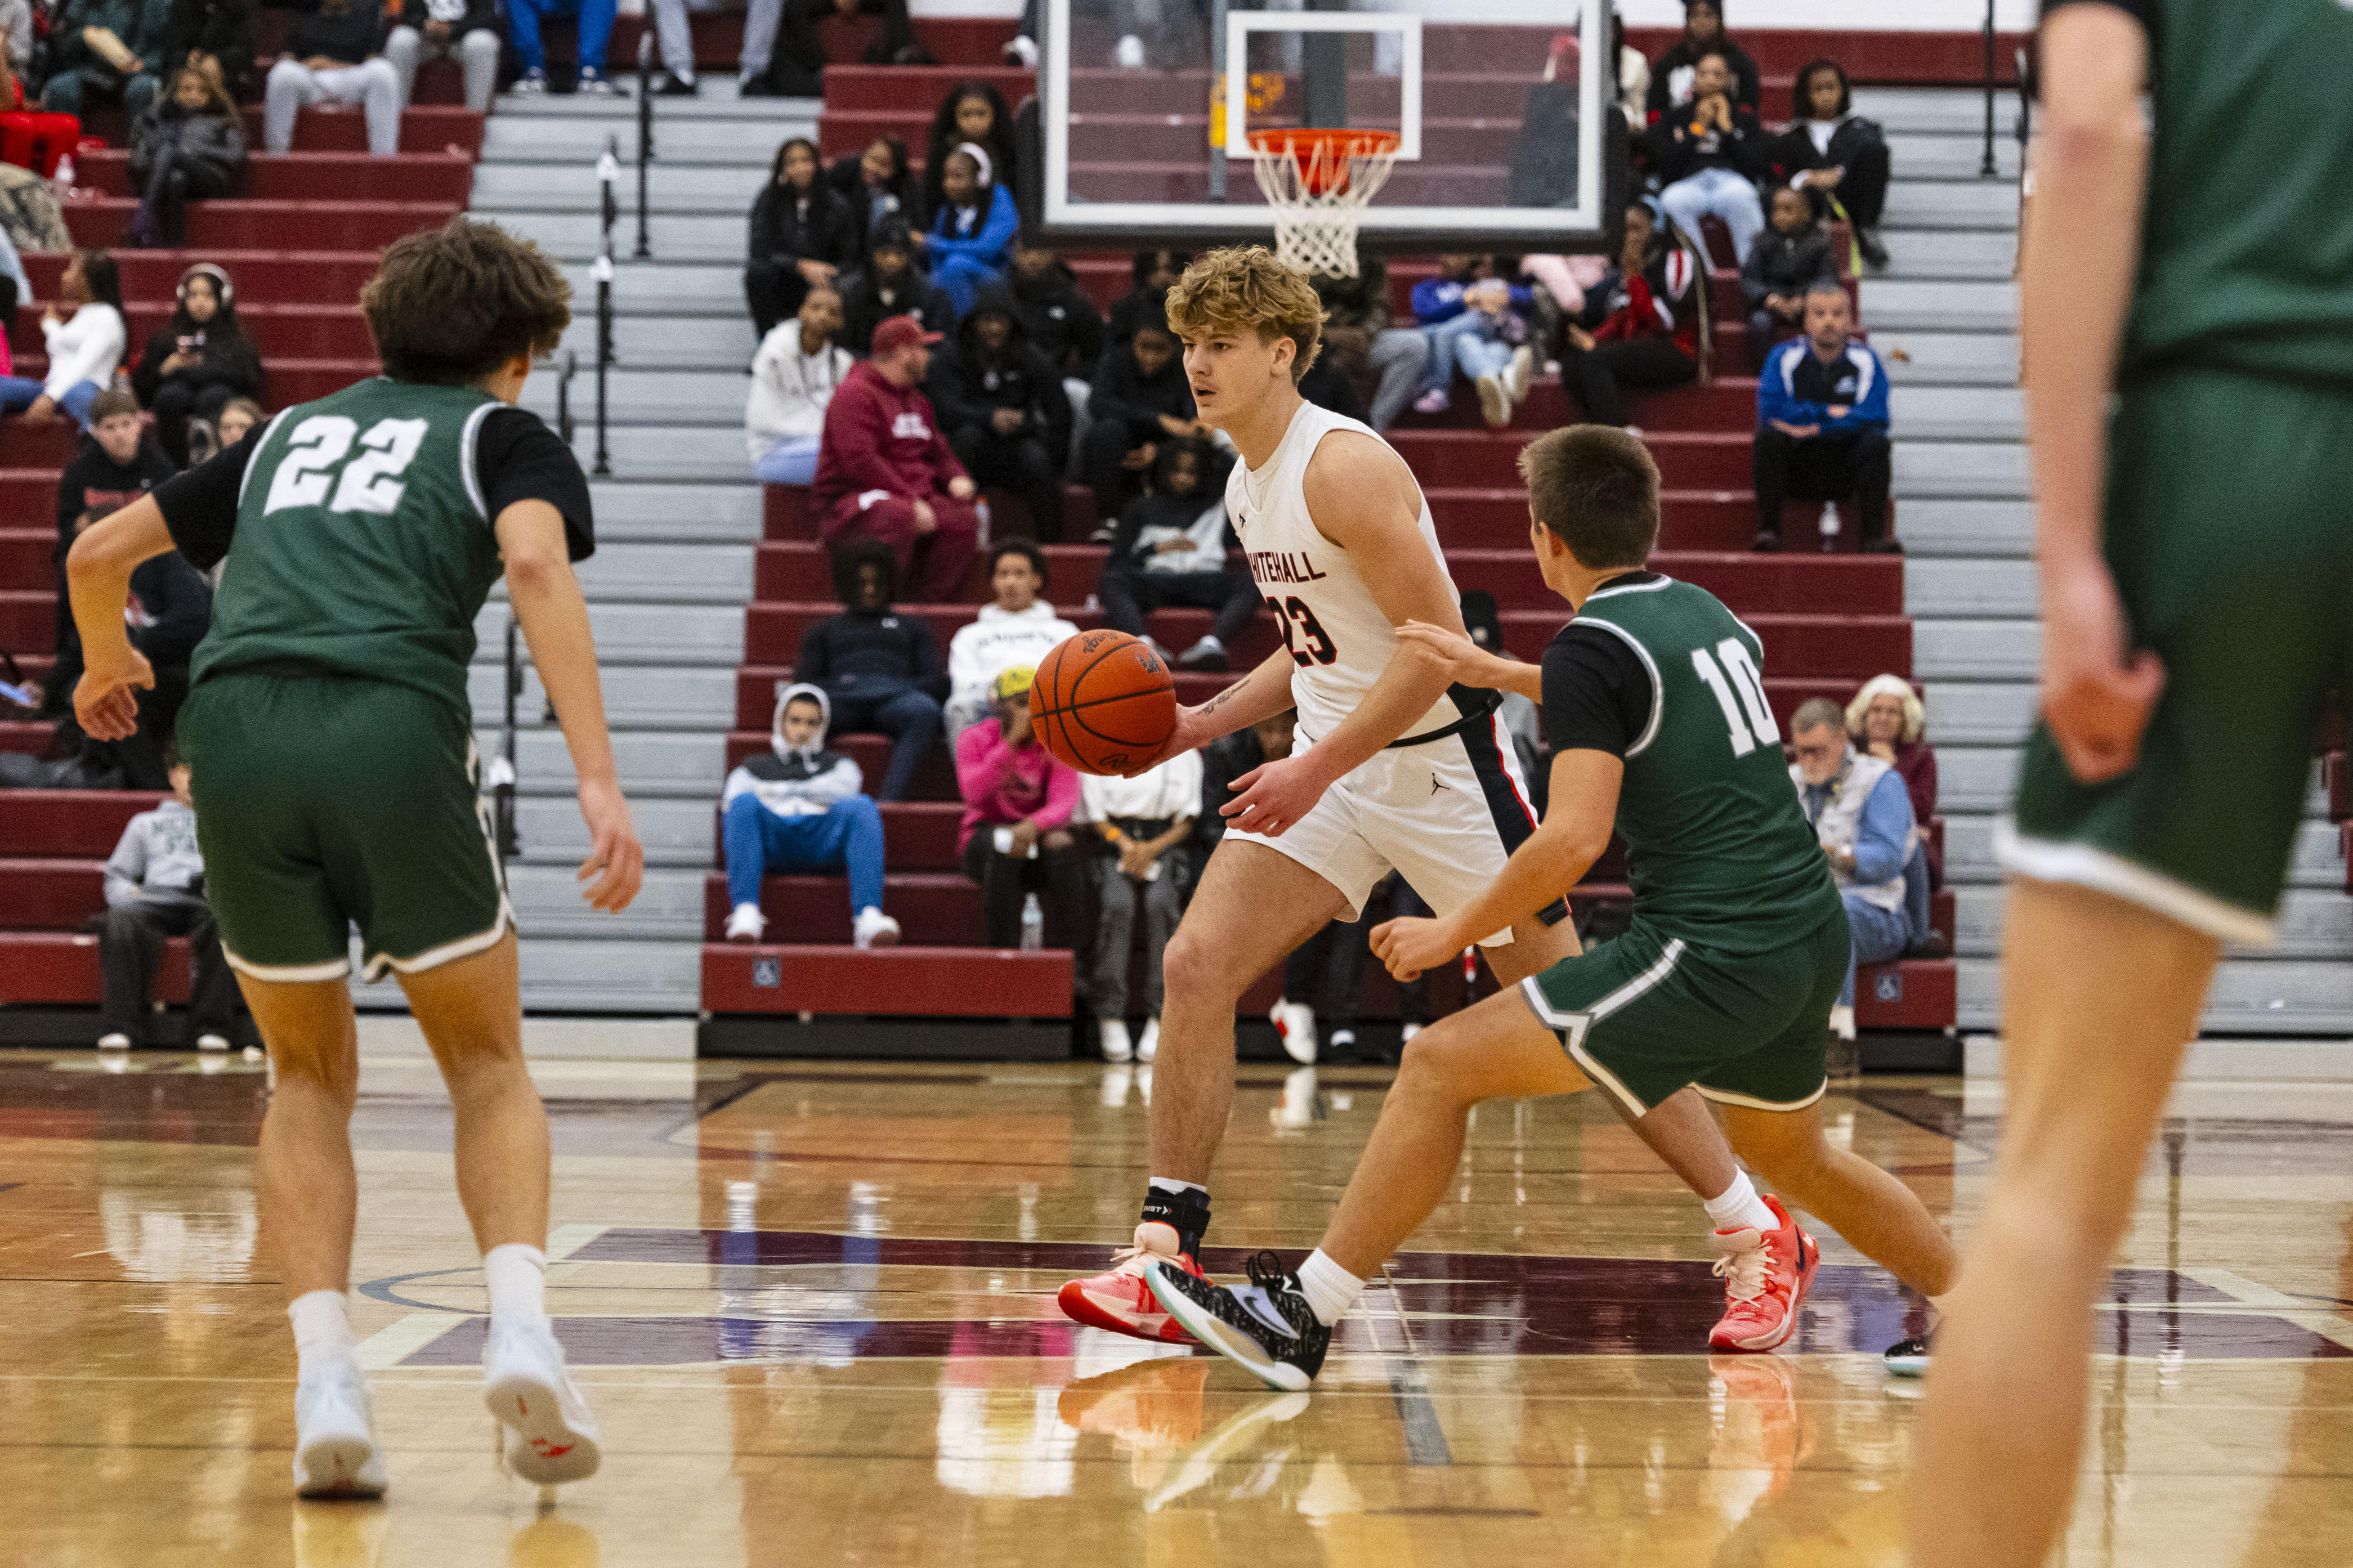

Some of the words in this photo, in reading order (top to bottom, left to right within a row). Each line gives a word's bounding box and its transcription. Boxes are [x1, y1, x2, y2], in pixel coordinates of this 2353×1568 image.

[263, 415, 428, 516] 22
[1248, 552, 1327, 583] HITEHALL
[1266, 595, 1337, 667] 23
[1690, 636, 1781, 759] 10
